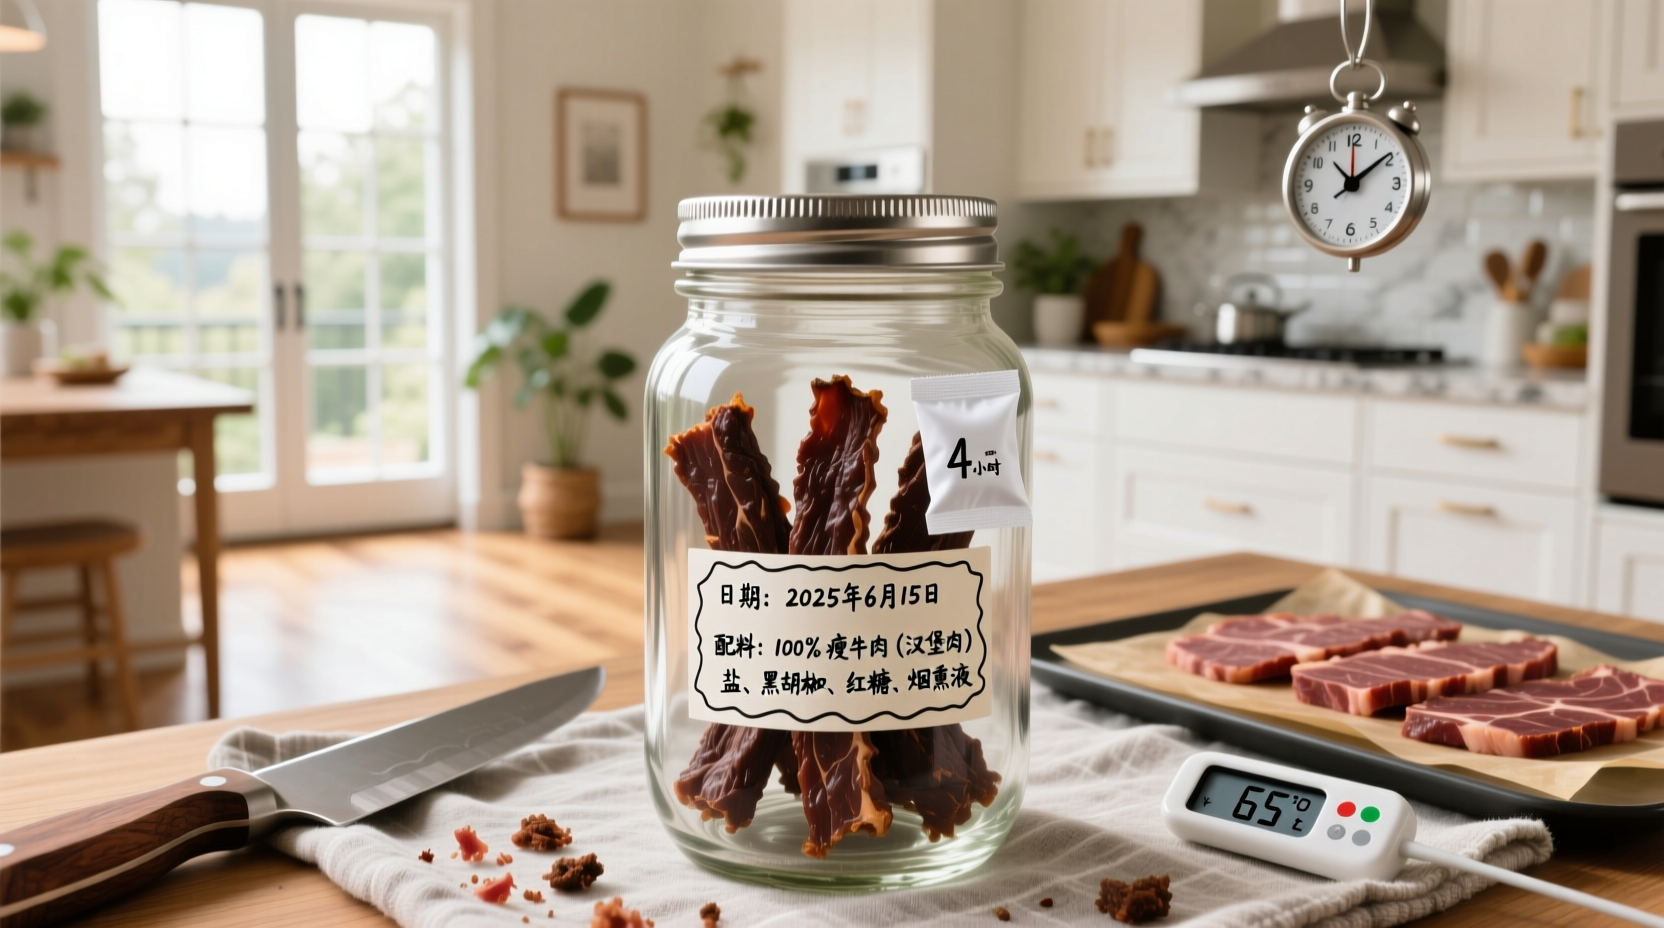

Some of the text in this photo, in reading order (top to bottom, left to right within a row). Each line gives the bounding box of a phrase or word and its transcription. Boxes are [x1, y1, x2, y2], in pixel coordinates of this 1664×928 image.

[1328, 141, 1337, 152] 11
[1347, 133, 1362, 148] 12
[1374, 138, 1378, 150] 1
[1312, 156, 1324, 169] 10
[1384, 152, 1394, 167] 2
[1304, 179, 1313, 193] 9
[1391, 176, 1401, 191] 3
[1310, 202, 1319, 215] 8
[1384, 201, 1393, 213] 4
[1324, 218, 1333, 229] 7
[1345, 222, 1356, 237] 6
[1369, 217, 1378, 229] 5
[1232, 785, 1290, 827] 65
